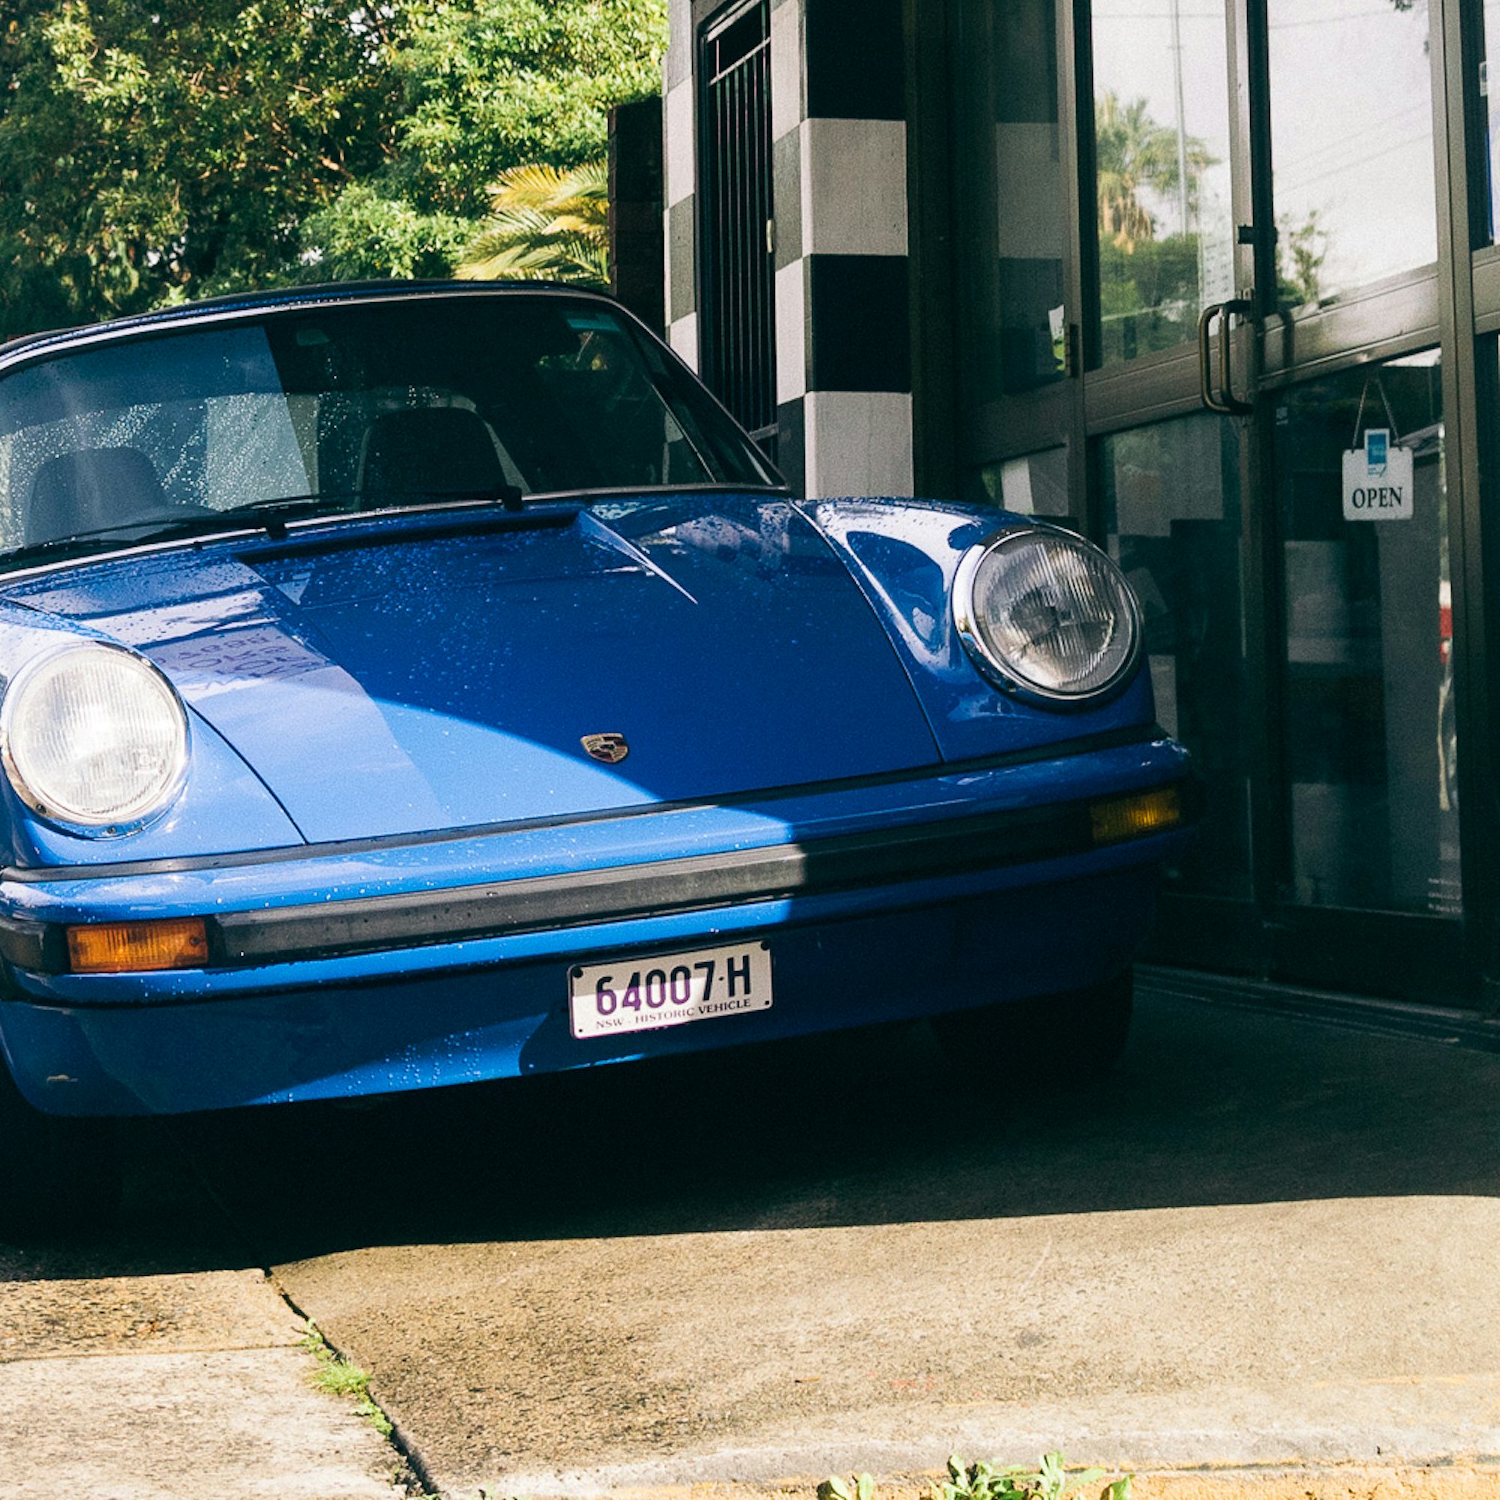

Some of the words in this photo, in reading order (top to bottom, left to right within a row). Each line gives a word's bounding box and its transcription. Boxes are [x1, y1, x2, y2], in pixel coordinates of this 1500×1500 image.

[1352, 486, 1402, 509] OPEN
[596, 1018, 624, 1030] NSW
[635, 1007, 695, 1024] HISTORIC
[698, 998, 751, 1015] VEHICLE
